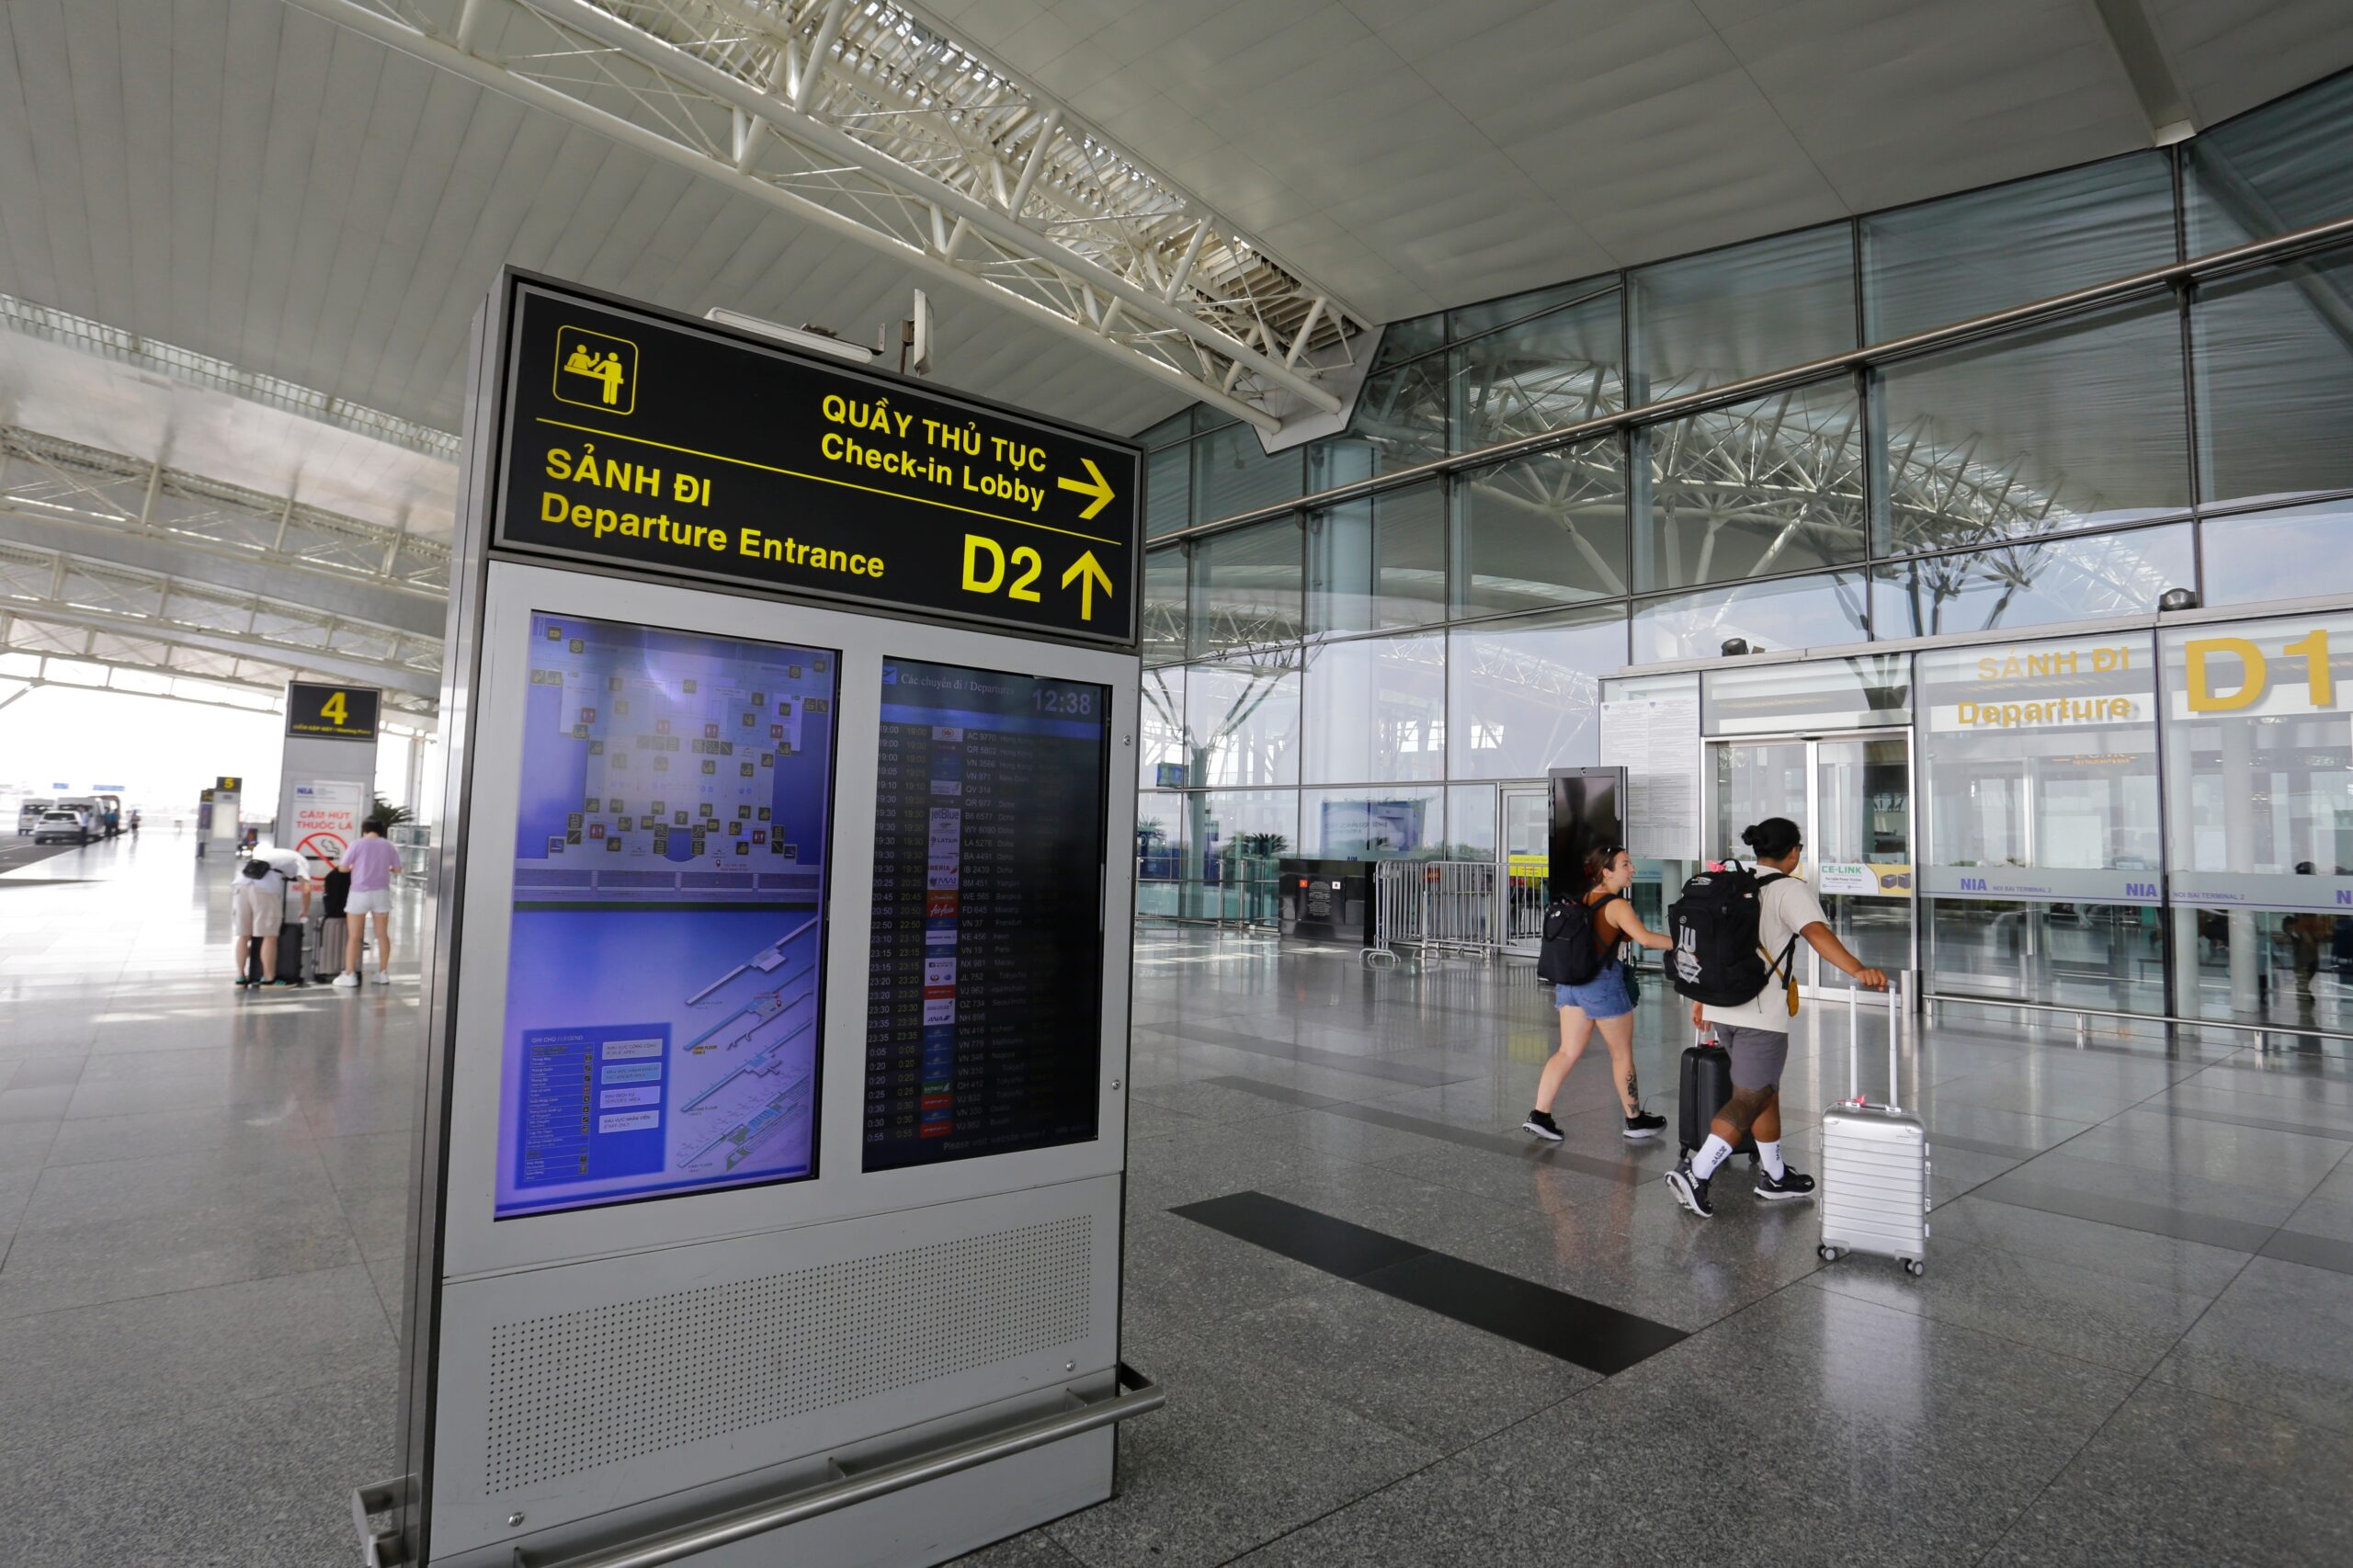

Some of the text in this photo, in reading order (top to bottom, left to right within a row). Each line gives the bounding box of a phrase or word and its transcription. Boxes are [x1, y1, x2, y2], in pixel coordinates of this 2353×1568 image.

[822, 394, 1047, 472] QUẦY THỦ TỤC
[545, 442, 711, 507] SẢNH ĐI
[821, 432, 1045, 512] Check-in Lobby
[540, 491, 885, 578] Departure Entrance
[961, 533, 1042, 603] D2
[1977, 646, 2131, 681] SẢNH ĐI
[2184, 628, 2333, 713] D1
[1032, 689, 1092, 715] 12:38
[320, 691, 348, 726] 4
[1958, 697, 2131, 728] Departure
[224, 778, 235, 790] 5
[876, 809, 896, 817] 19:30
[875, 823, 895, 831] 19:30
[875, 837, 895, 845] 19:30
[875, 851, 894, 859] 19:30
[874, 865, 894, 873] 19:30
[1822, 865, 1862, 874] CE-LINK
[873, 879, 893, 887] 20:25
[1961, 878, 1987, 891] NIA
[2126, 883, 2158, 897] NIA
[873, 893, 893, 901] 20:45
[871, 921, 892, 929] 22:50
[871, 935, 892, 943] 23:10
[870, 949, 891, 957] 23:15
[870, 963, 891, 971] 23:15
[870, 977, 890, 986] 23:20
[869, 992, 890, 1000] 23:20
[869, 1006, 889, 1014] 23:30
[869, 1020, 889, 1029] 23:35
[868, 1034, 889, 1043] 23:35
[870, 1049, 887, 1057] 0:05
[869, 1062, 886, 1071] 0:20
[869, 1076, 886, 1085] 0:20
[869, 1091, 886, 1099] 0:25
[868, 1105, 885, 1113] 0:30
[868, 1119, 884, 1127] 0:30
[868, 1134, 884, 1142] 0:55
